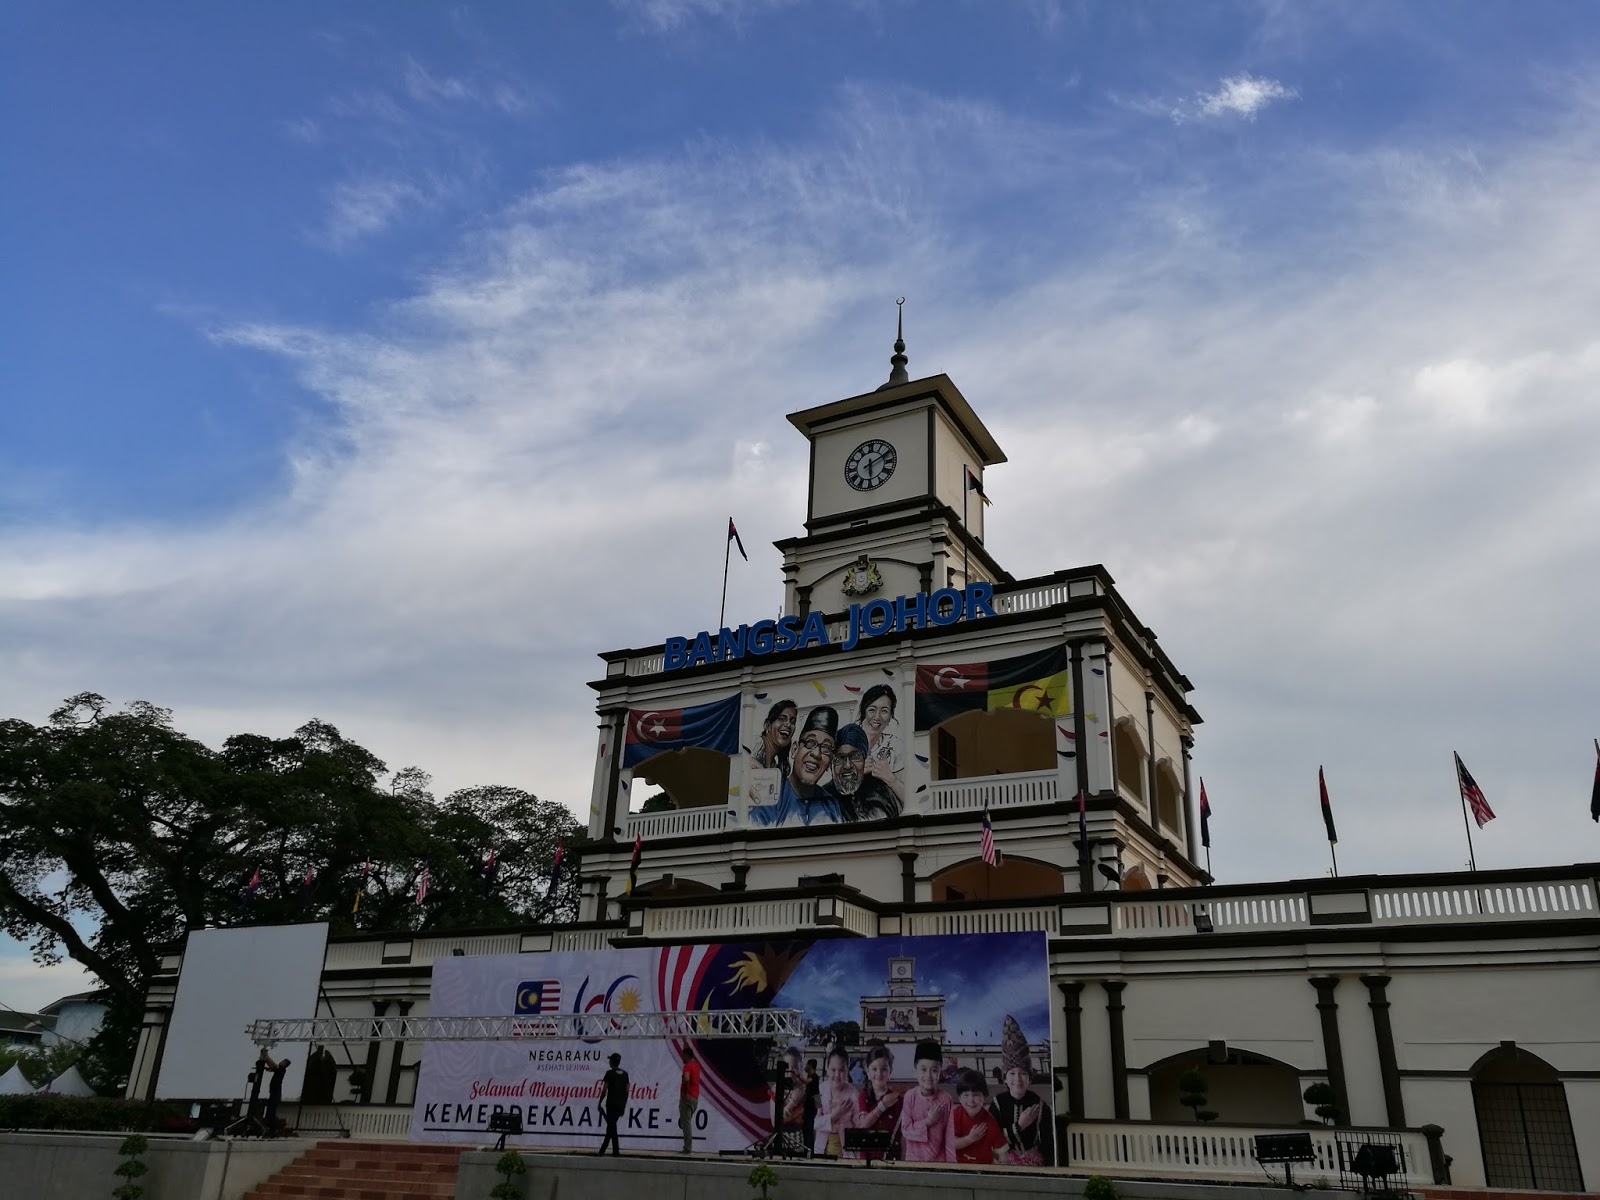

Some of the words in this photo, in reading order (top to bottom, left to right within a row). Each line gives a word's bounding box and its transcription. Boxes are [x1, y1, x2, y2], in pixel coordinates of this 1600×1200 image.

[663, 610, 830, 672] BANGSA
[842, 582, 997, 650] JOHOR
[529, 1050, 601, 1062] NEGARAKU
[470, 1077, 528, 1100] Selamat
[529, 1079, 604, 1107] Menyamb
[628, 1107, 708, 1131] KE-0
